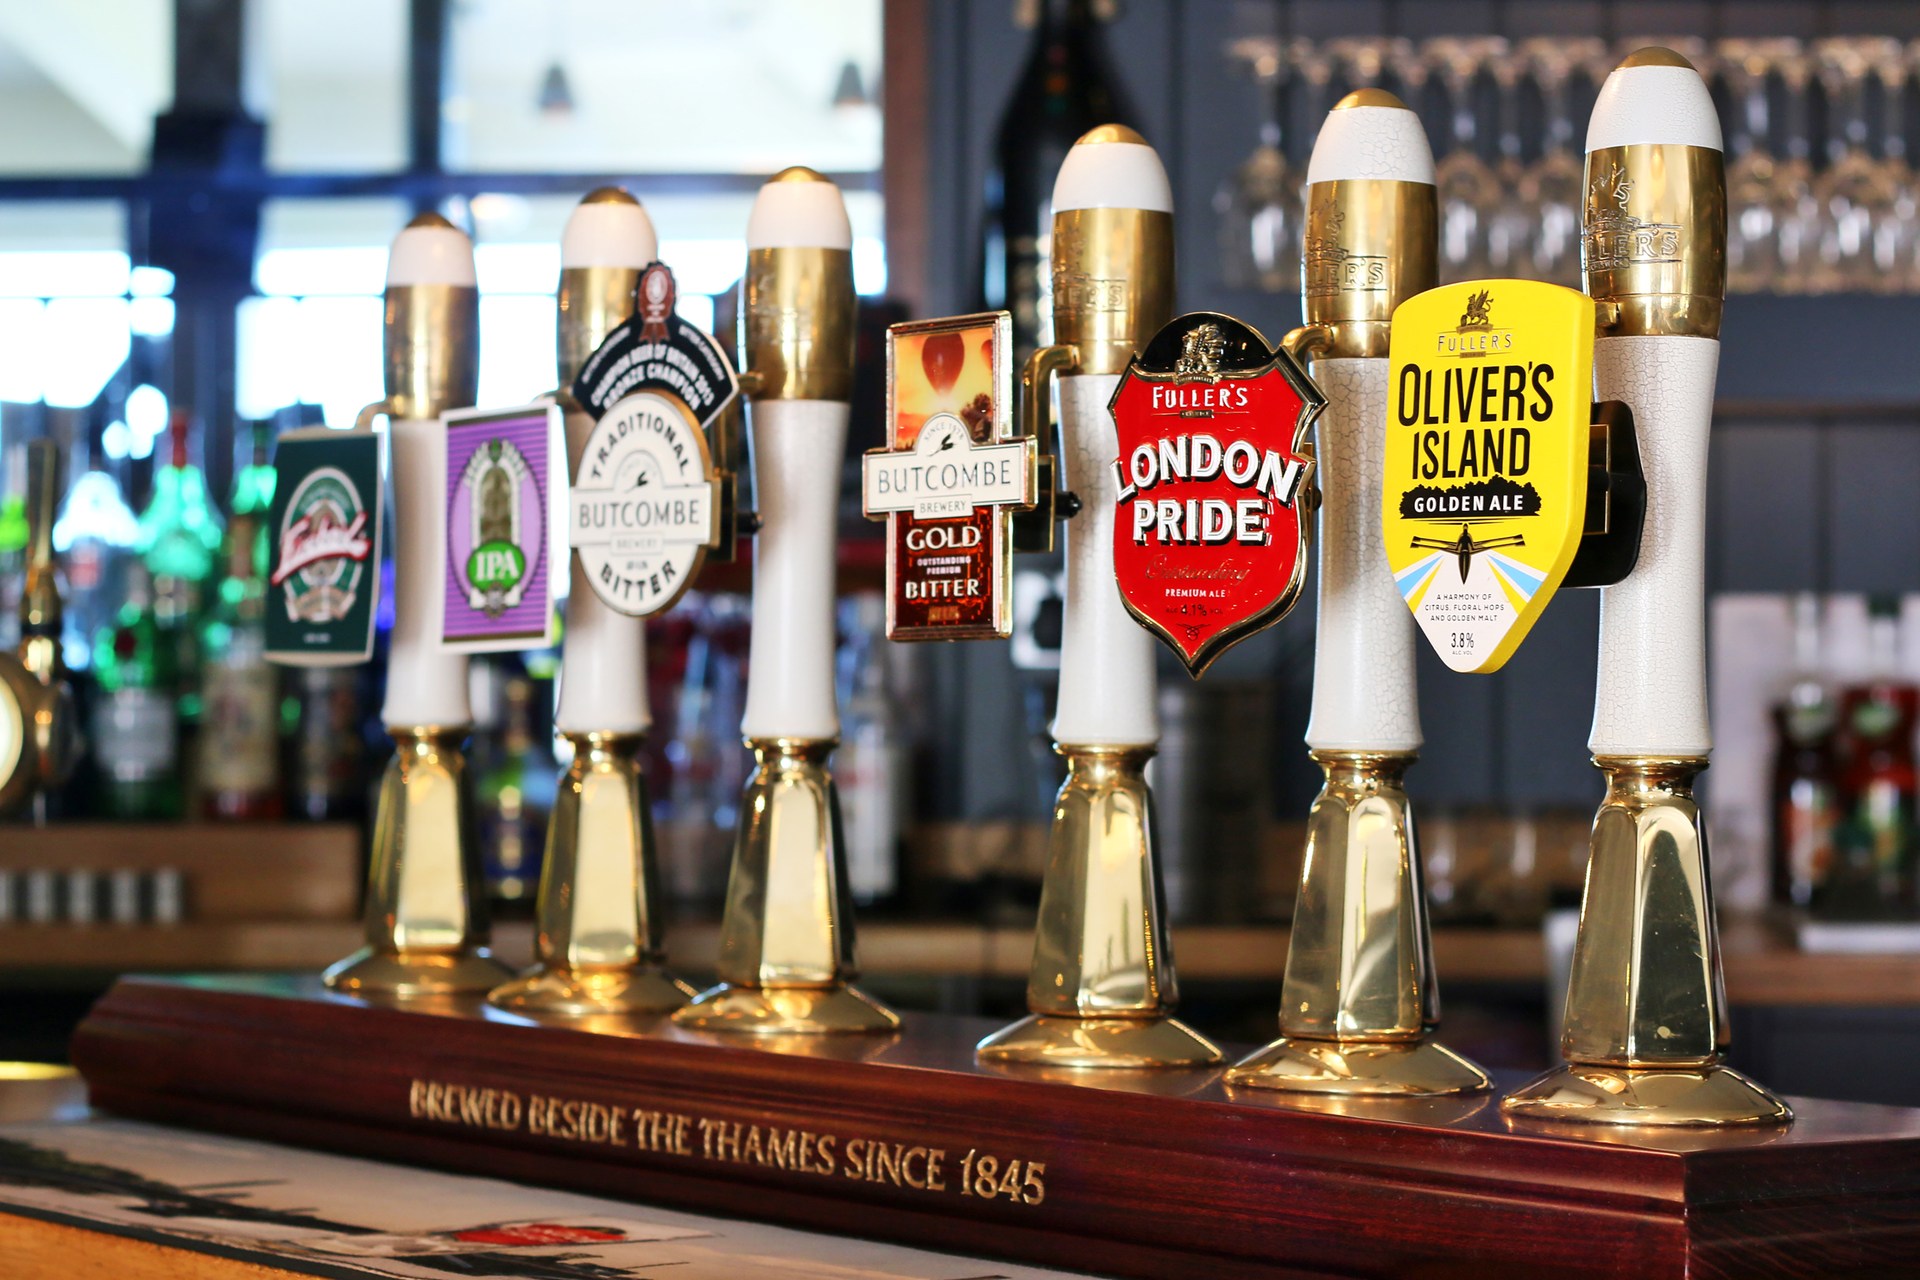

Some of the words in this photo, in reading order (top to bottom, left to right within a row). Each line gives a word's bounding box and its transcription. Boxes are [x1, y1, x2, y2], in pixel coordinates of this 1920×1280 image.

[1438, 331, 1512, 352] FULLER'S
[1152, 383, 1248, 409] FULLER'S
[1398, 361, 1555, 427] OLIVER'S
[591, 412, 690, 480] TRADITIONAL
[1412, 427, 1531, 480] ISLAND
[879, 459, 1011, 494] BUTCOMBE
[1110, 434, 1306, 510] LONDON
[579, 499, 700, 528] BUTCOMBE
[919, 500, 967, 514] BREWERY
[1414, 495, 1484, 513] GOLDEN
[1489, 494, 1524, 511] ALE
[1132, 499, 1268, 546] PRIDE
[906, 526, 981, 550] GOLD
[475, 550, 520, 582] IPA
[917, 555, 972, 567] OUTSTANDING
[926, 566, 962, 575] PREMIUM
[600, 560, 676, 601] BITTER
[905, 578, 980, 599] BITTER
[1165, 588, 1207, 598] PREMIUM
[1209, 589, 1226, 598] ALE
[1180, 604, 1208, 617] 4.1%
[1430, 614, 1445, 622] AND
[1447, 614, 1476, 622] GOLDEN
[1450, 632, 1475, 648] 3.8%
[410, 1079, 521, 1131] BREWED
[528, 1094, 627, 1147] BESIDE
[633, 1107, 693, 1156] THE
[699, 1117, 836, 1176] THAMES
[844, 1138, 945, 1191] SINCE
[960, 1148, 1047, 1206] 1845
